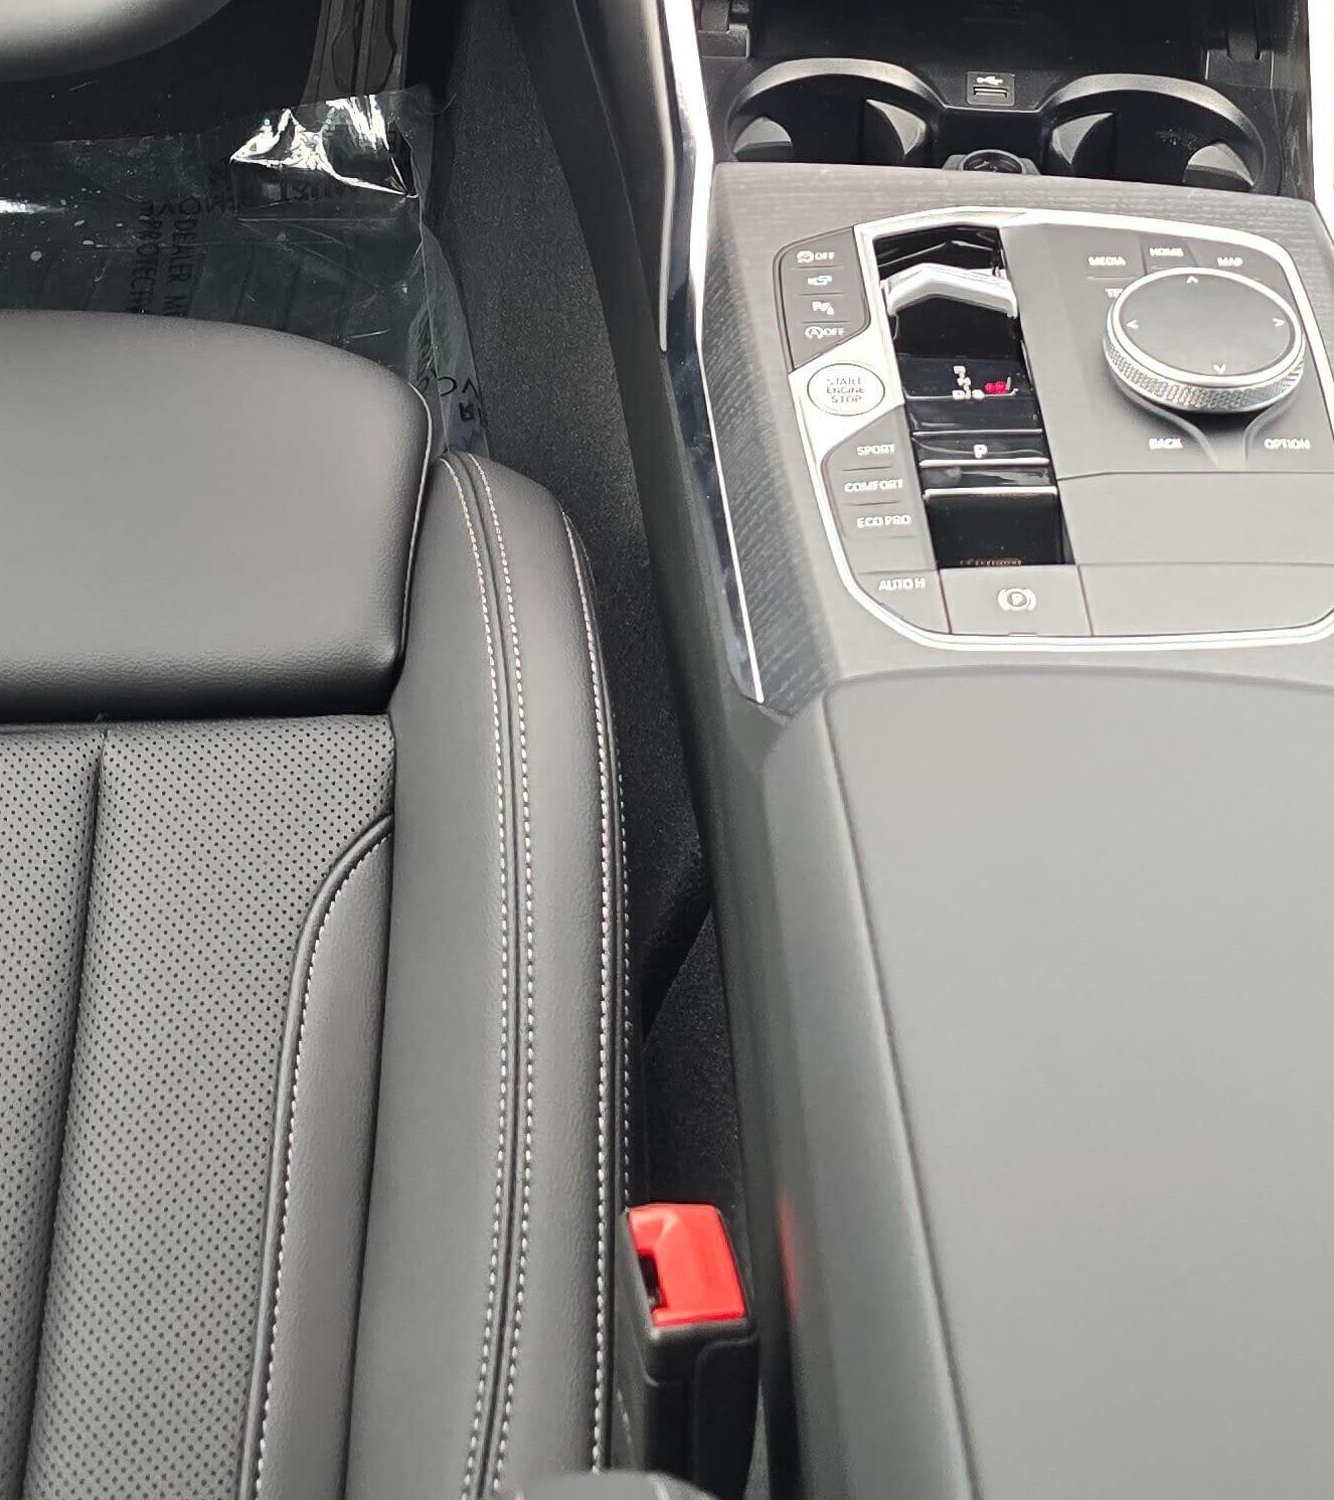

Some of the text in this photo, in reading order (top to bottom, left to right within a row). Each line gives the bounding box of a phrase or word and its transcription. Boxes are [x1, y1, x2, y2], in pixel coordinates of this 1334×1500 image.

[856, 443, 896, 456] SPORT
[1148, 438, 1183, 449] BACK
[1263, 438, 1312, 450] OPTION
[973, 444, 988, 459] P
[844, 478, 904, 493] COMFORT
[856, 514, 912, 528] ECO PRO
[878, 577, 926, 591] AUTO H
